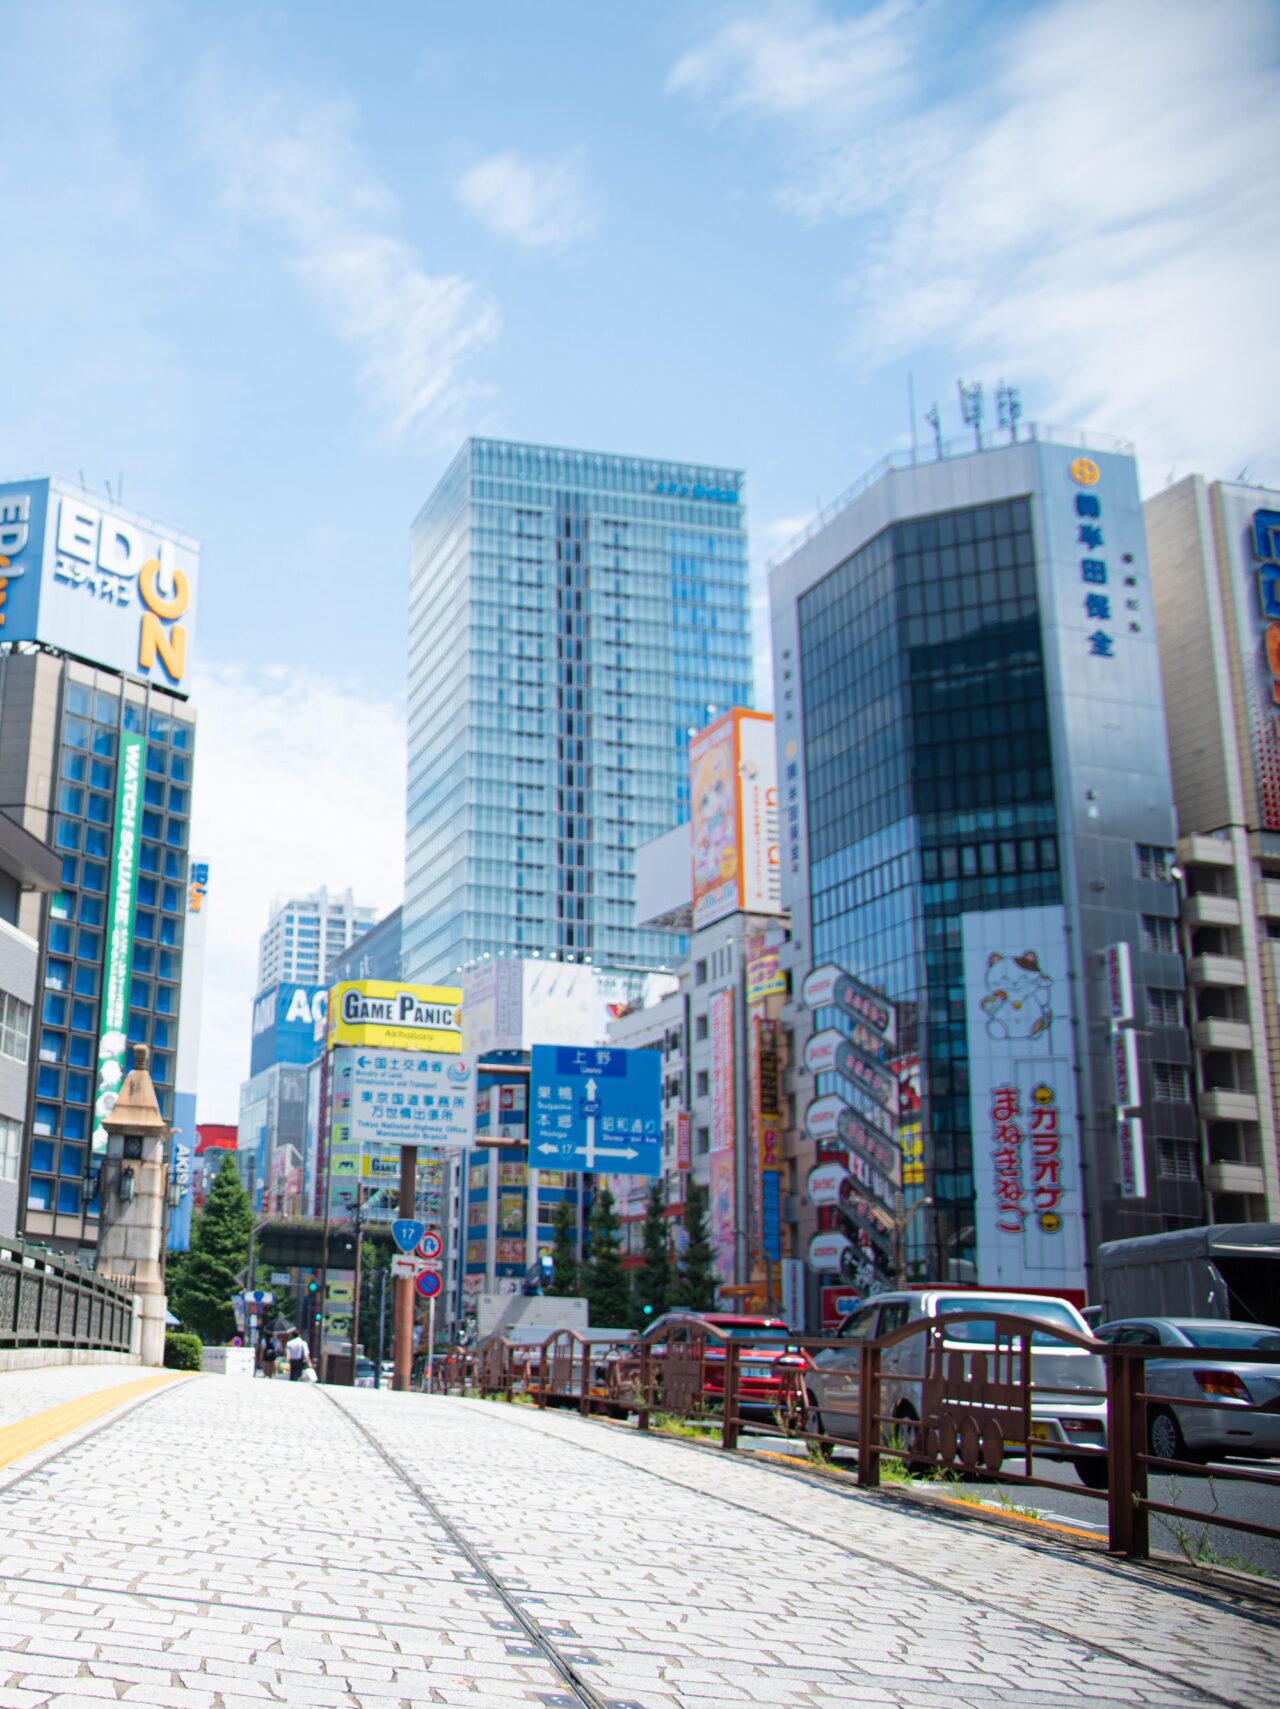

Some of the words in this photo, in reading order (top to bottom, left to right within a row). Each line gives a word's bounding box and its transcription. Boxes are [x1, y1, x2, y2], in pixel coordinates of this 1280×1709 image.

[56, 496, 190, 684] EDION
[122, 744, 140, 828] WATCH
[115, 828, 135, 924] SQUARE
[345, 993, 393, 1020] GAME
[400, 996, 452, 1025] PANIC
[375, 1057, 442, 1072] 国土交通省
[573, 1051, 611, 1065] 上野
[362, 1091, 464, 1108] 東京国道事務所
[538, 1086, 572, 1100] 巣鴨
[372, 1105, 453, 1121] 万世橋出張所
[537, 1114, 572, 1128] 本郷
[602, 1117, 655, 1133] 昭和通り
[562, 1144, 572, 1154] 17
[991, 1085, 1027, 1234] まねきねこ
[1030, 1108, 1061, 1210] カラオケ
[401, 1228, 415, 1239] 17
